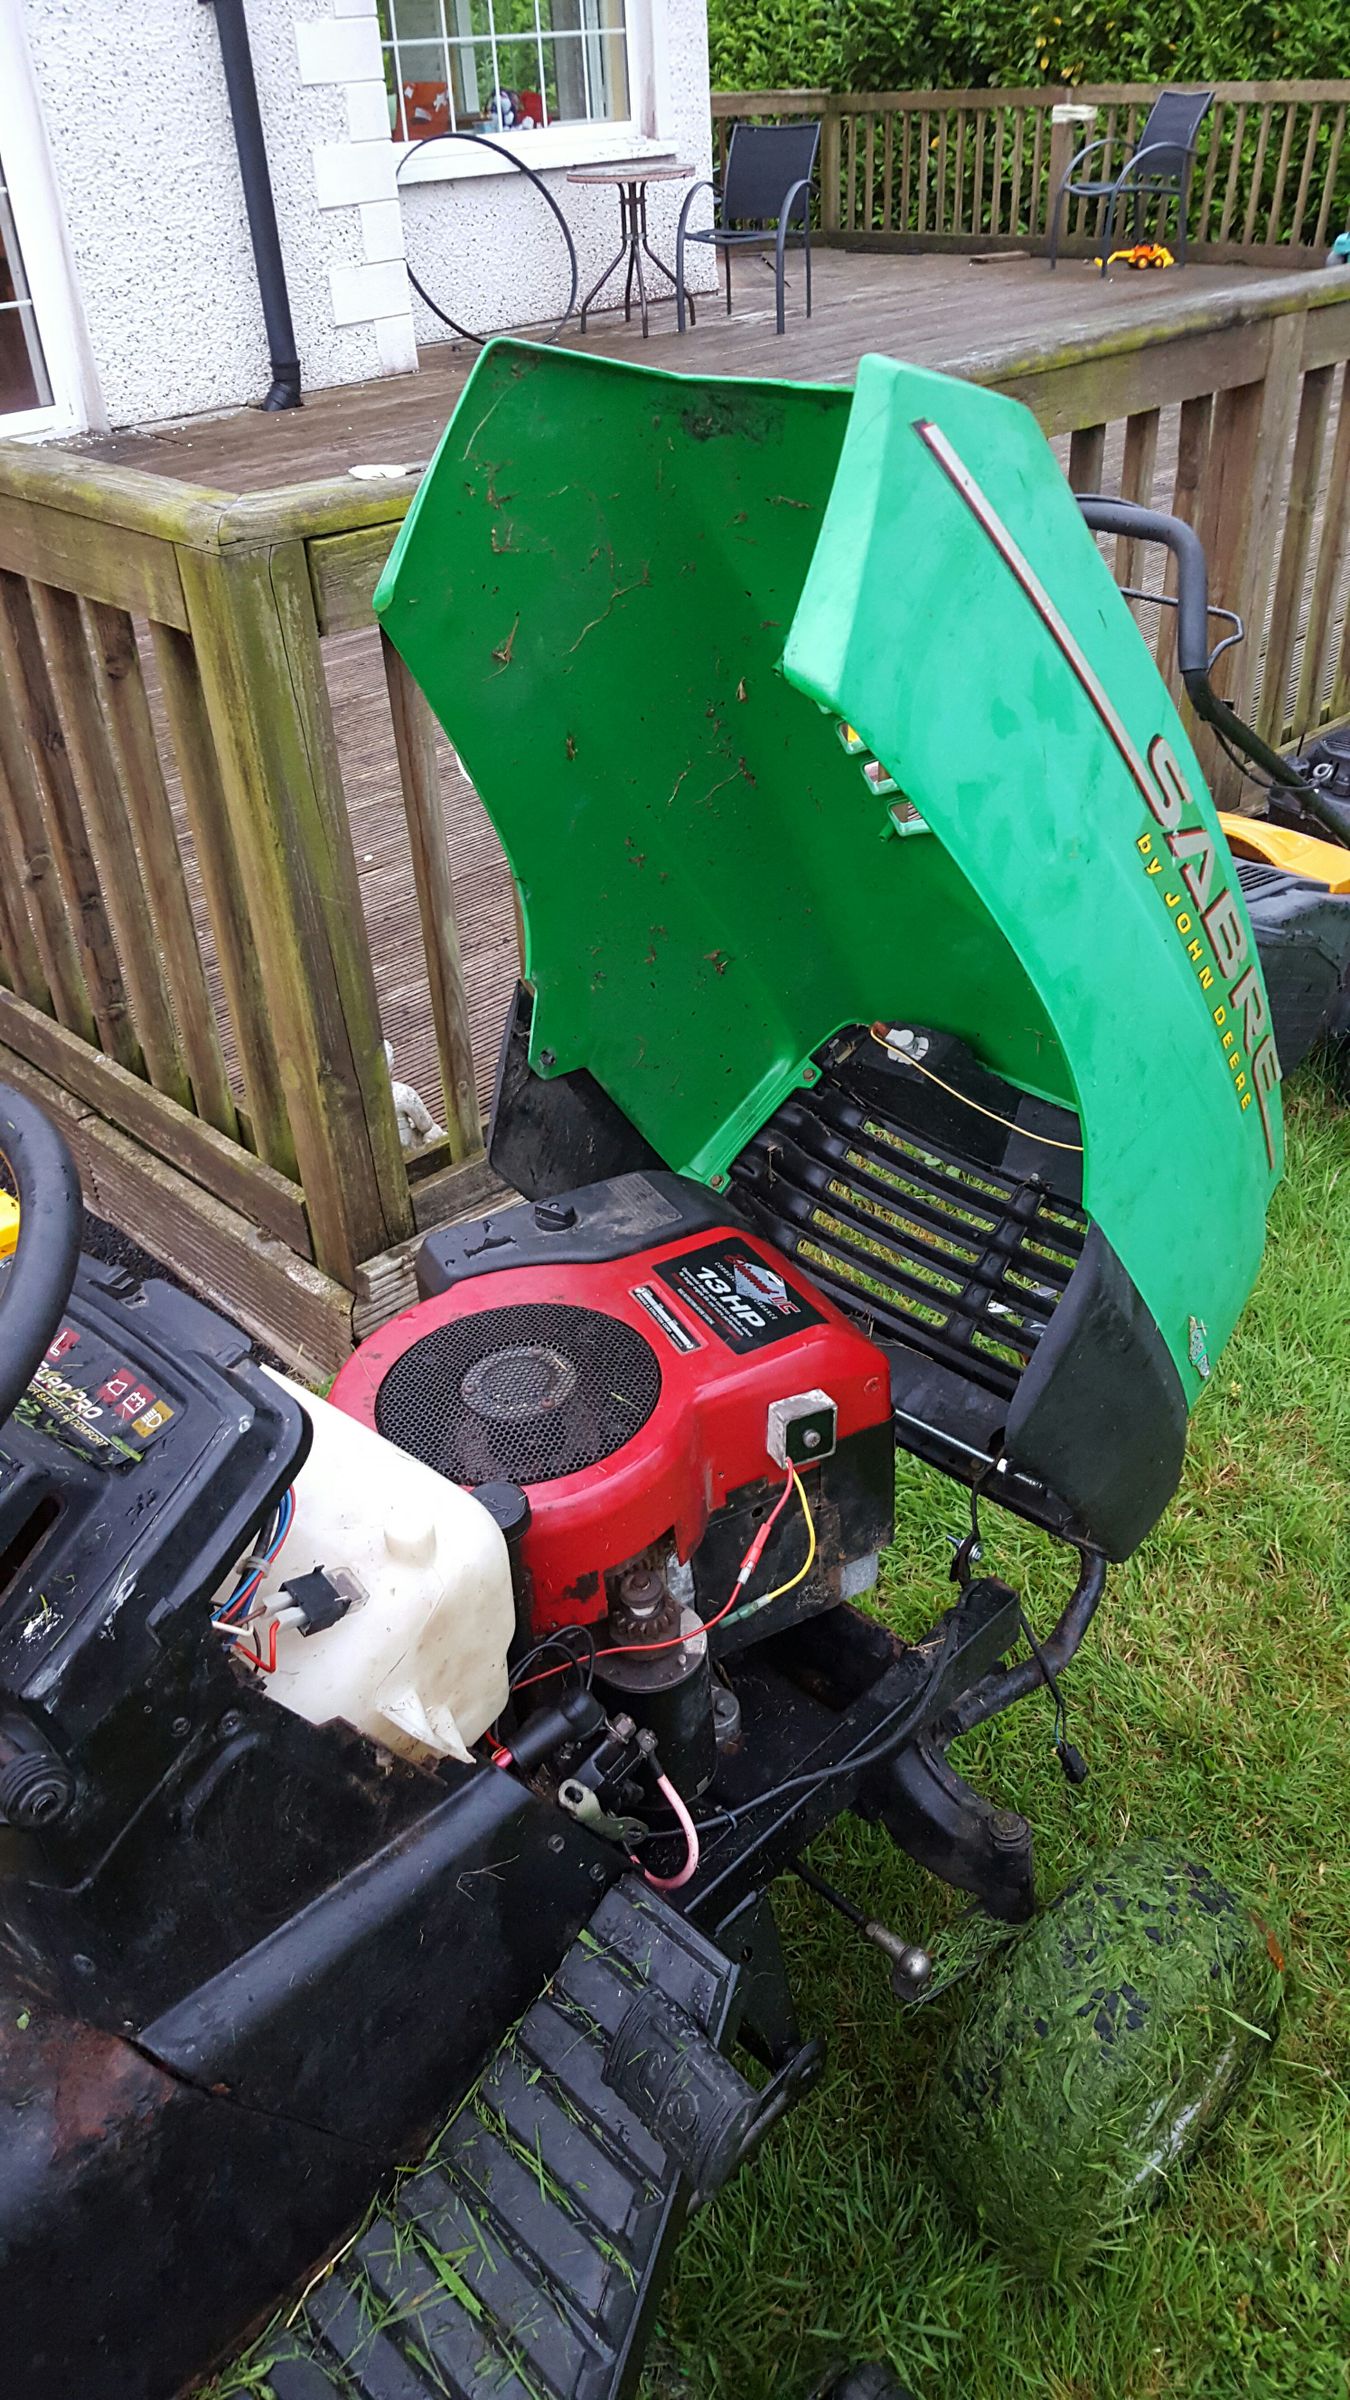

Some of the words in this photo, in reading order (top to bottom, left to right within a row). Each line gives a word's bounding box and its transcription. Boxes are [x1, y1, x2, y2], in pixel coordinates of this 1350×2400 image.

[1135, 832, 1162, 875] by
[1164, 890, 1214, 991] JOHN
[1212, 1004, 1252, 1111] DEERE
[1147, 733, 1283, 1168] SABRE
[696, 1266, 732, 1294] 13
[719, 1294, 766, 1327] HP
[36, 1391, 69, 1415] SAFETY
[70, 1419, 109, 1447] COMFORT
